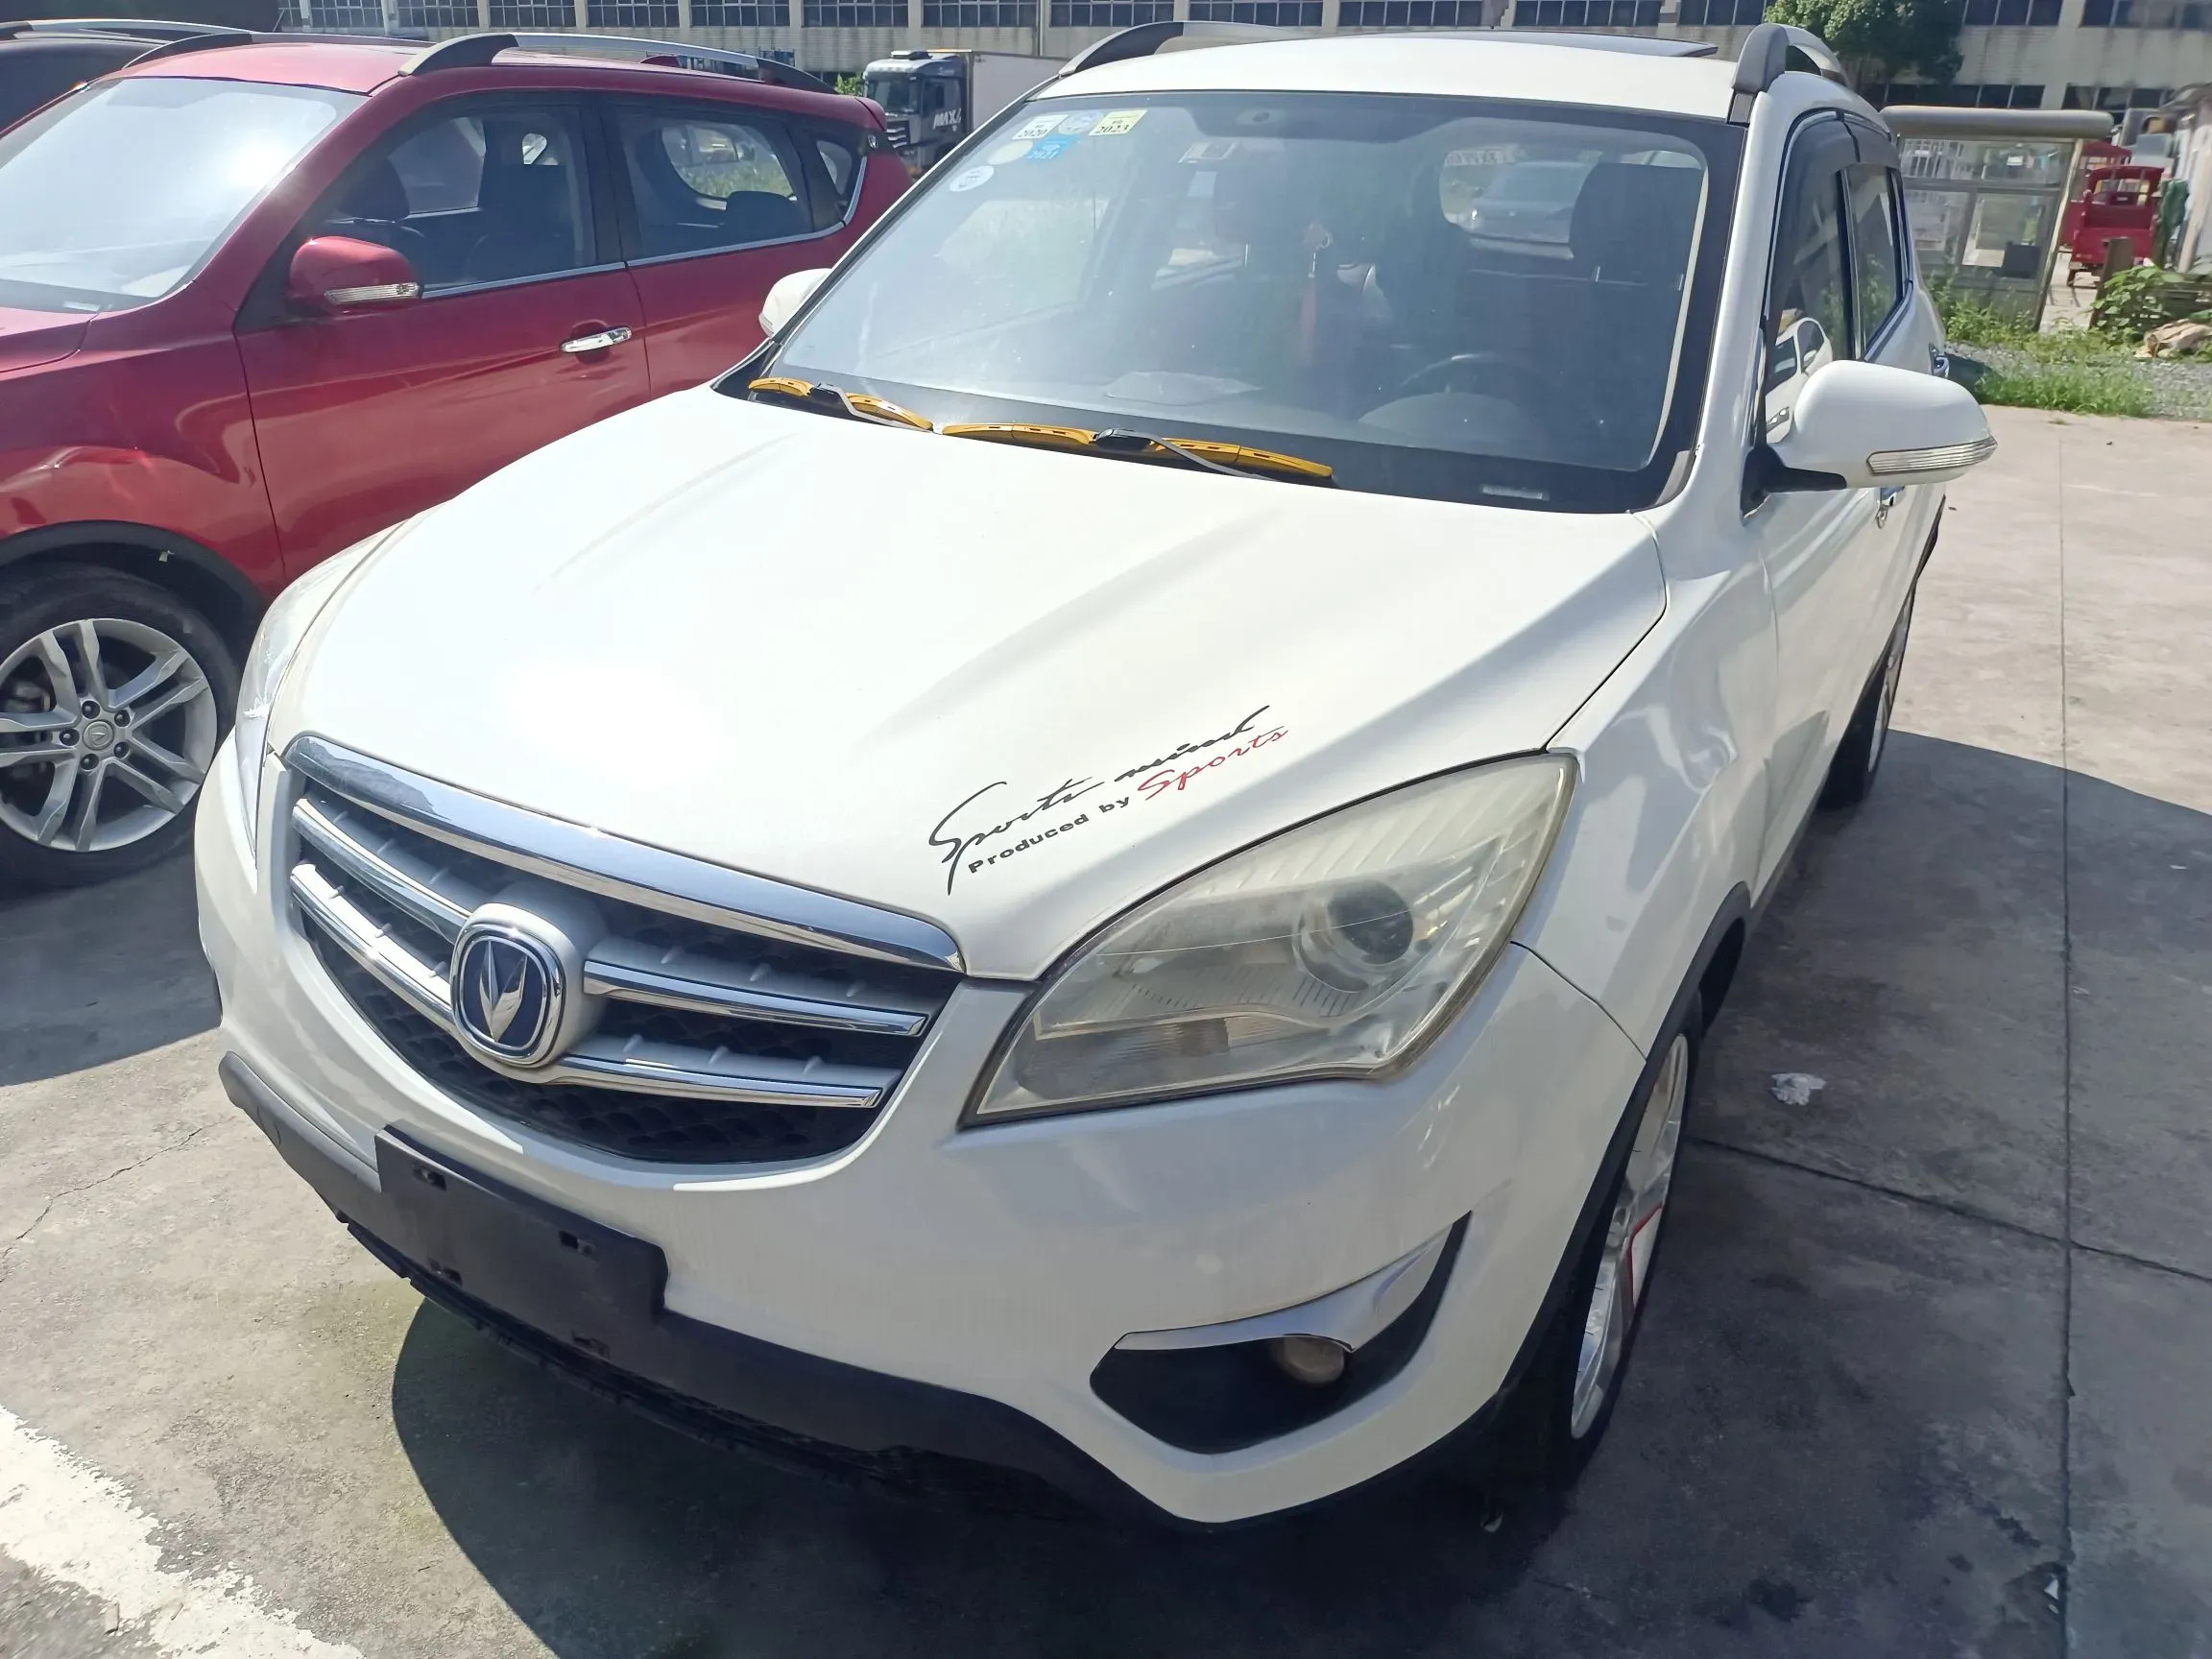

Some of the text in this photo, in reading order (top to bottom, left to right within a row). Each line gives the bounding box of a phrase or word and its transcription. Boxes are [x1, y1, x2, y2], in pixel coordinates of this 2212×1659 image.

[968, 726, 1288, 874] Produced by Sports
